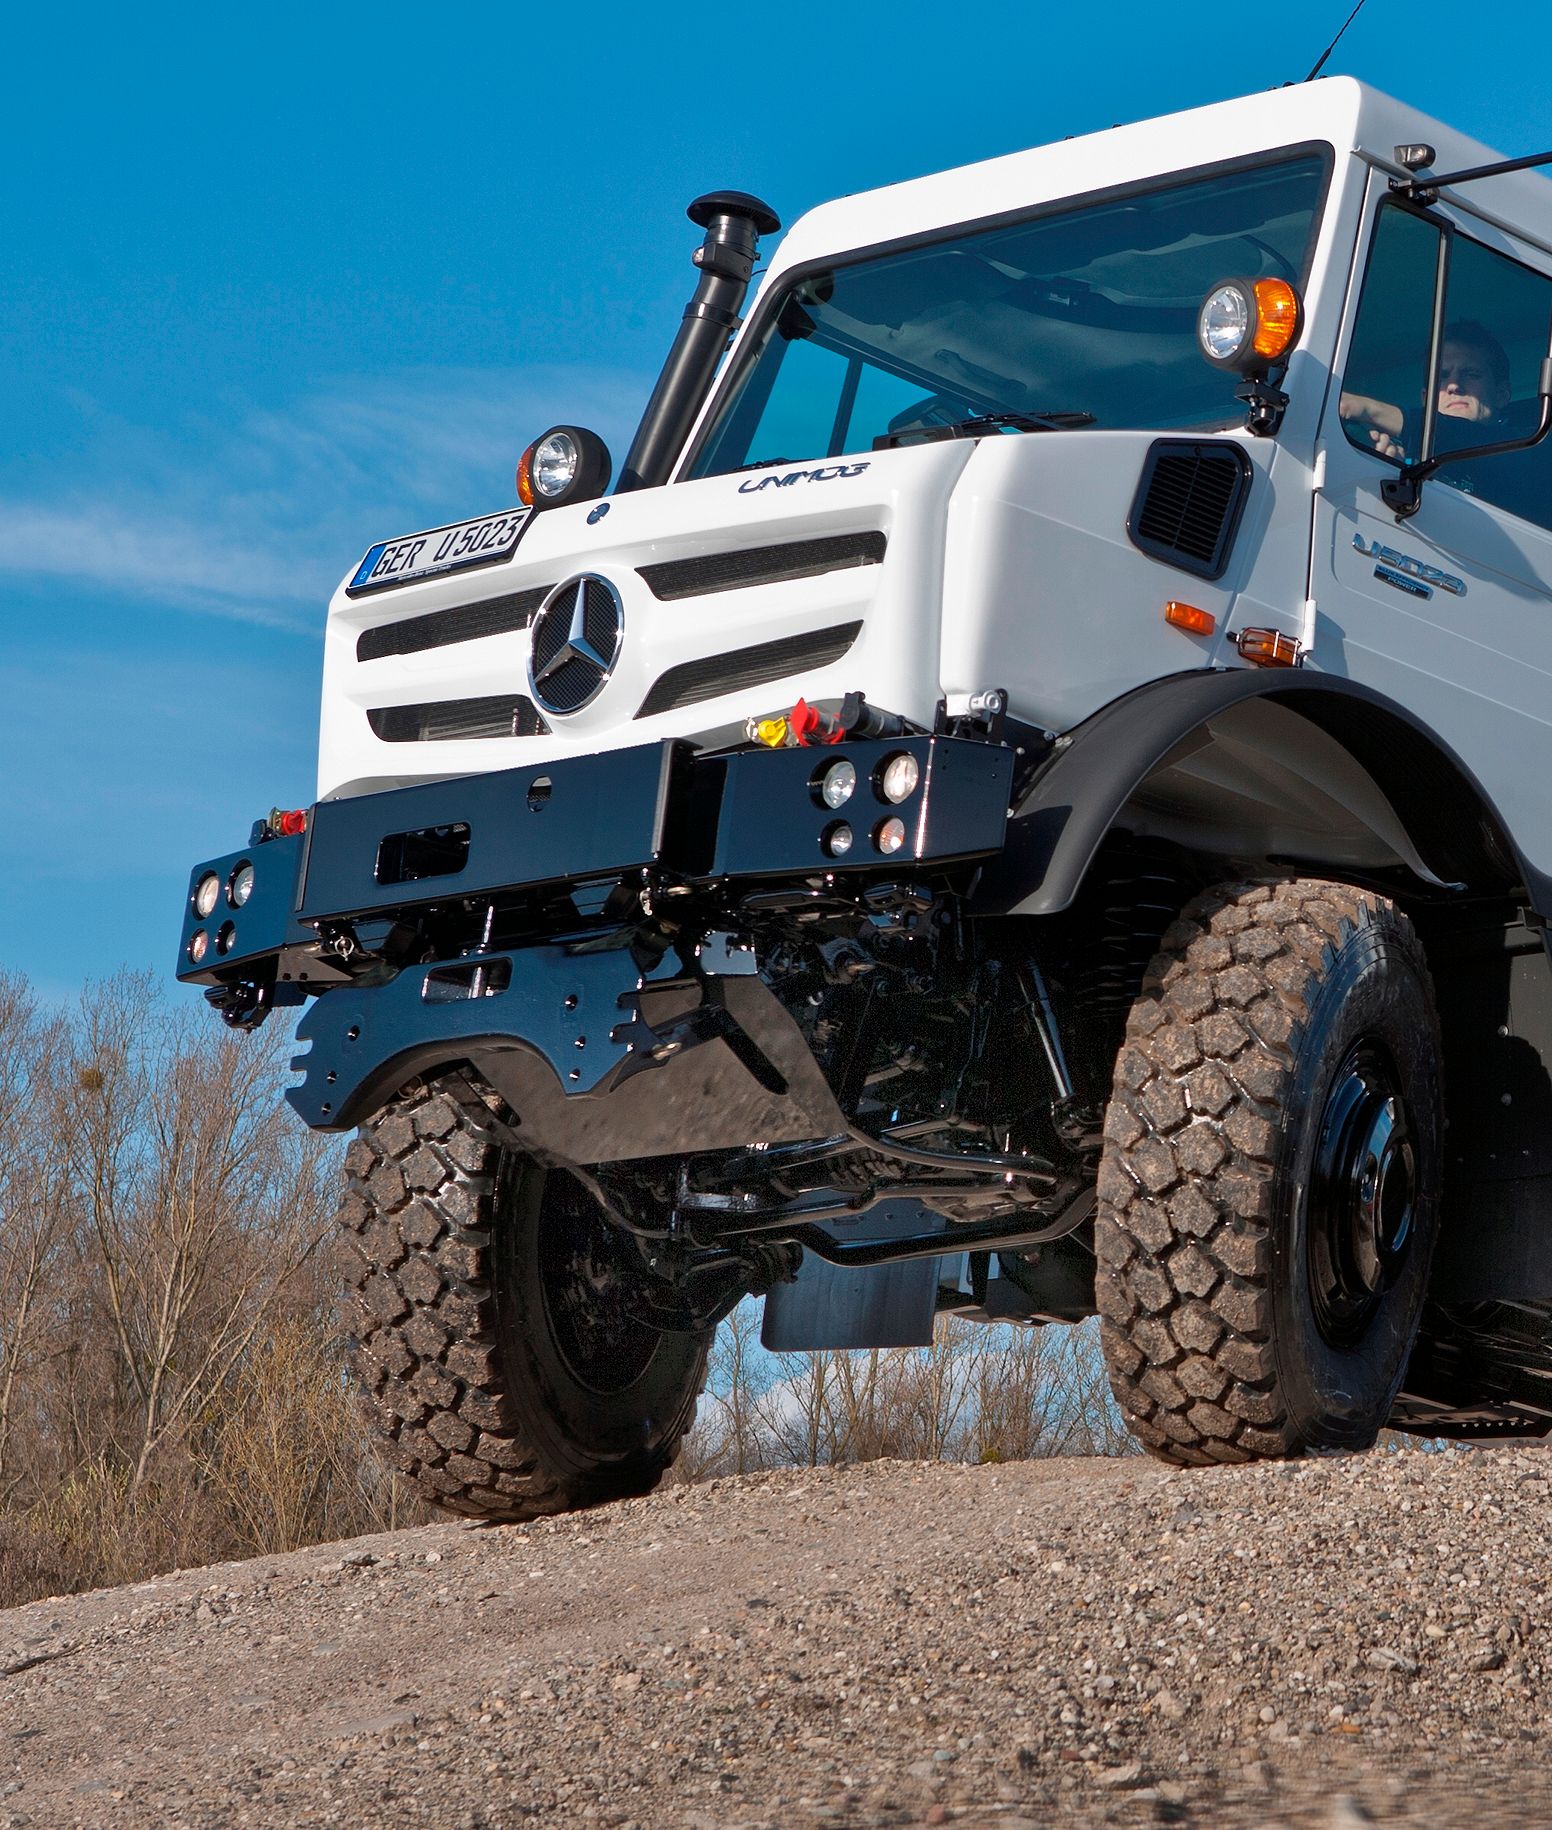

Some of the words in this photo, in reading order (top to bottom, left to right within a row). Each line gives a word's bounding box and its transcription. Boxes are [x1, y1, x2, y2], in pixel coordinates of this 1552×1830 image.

[738, 462, 871, 494] UNIMOG
[371, 539, 428, 578] GER
[433, 530, 457, 562] U
[453, 514, 526, 557] 5023
[1352, 532, 1468, 598] U5023
